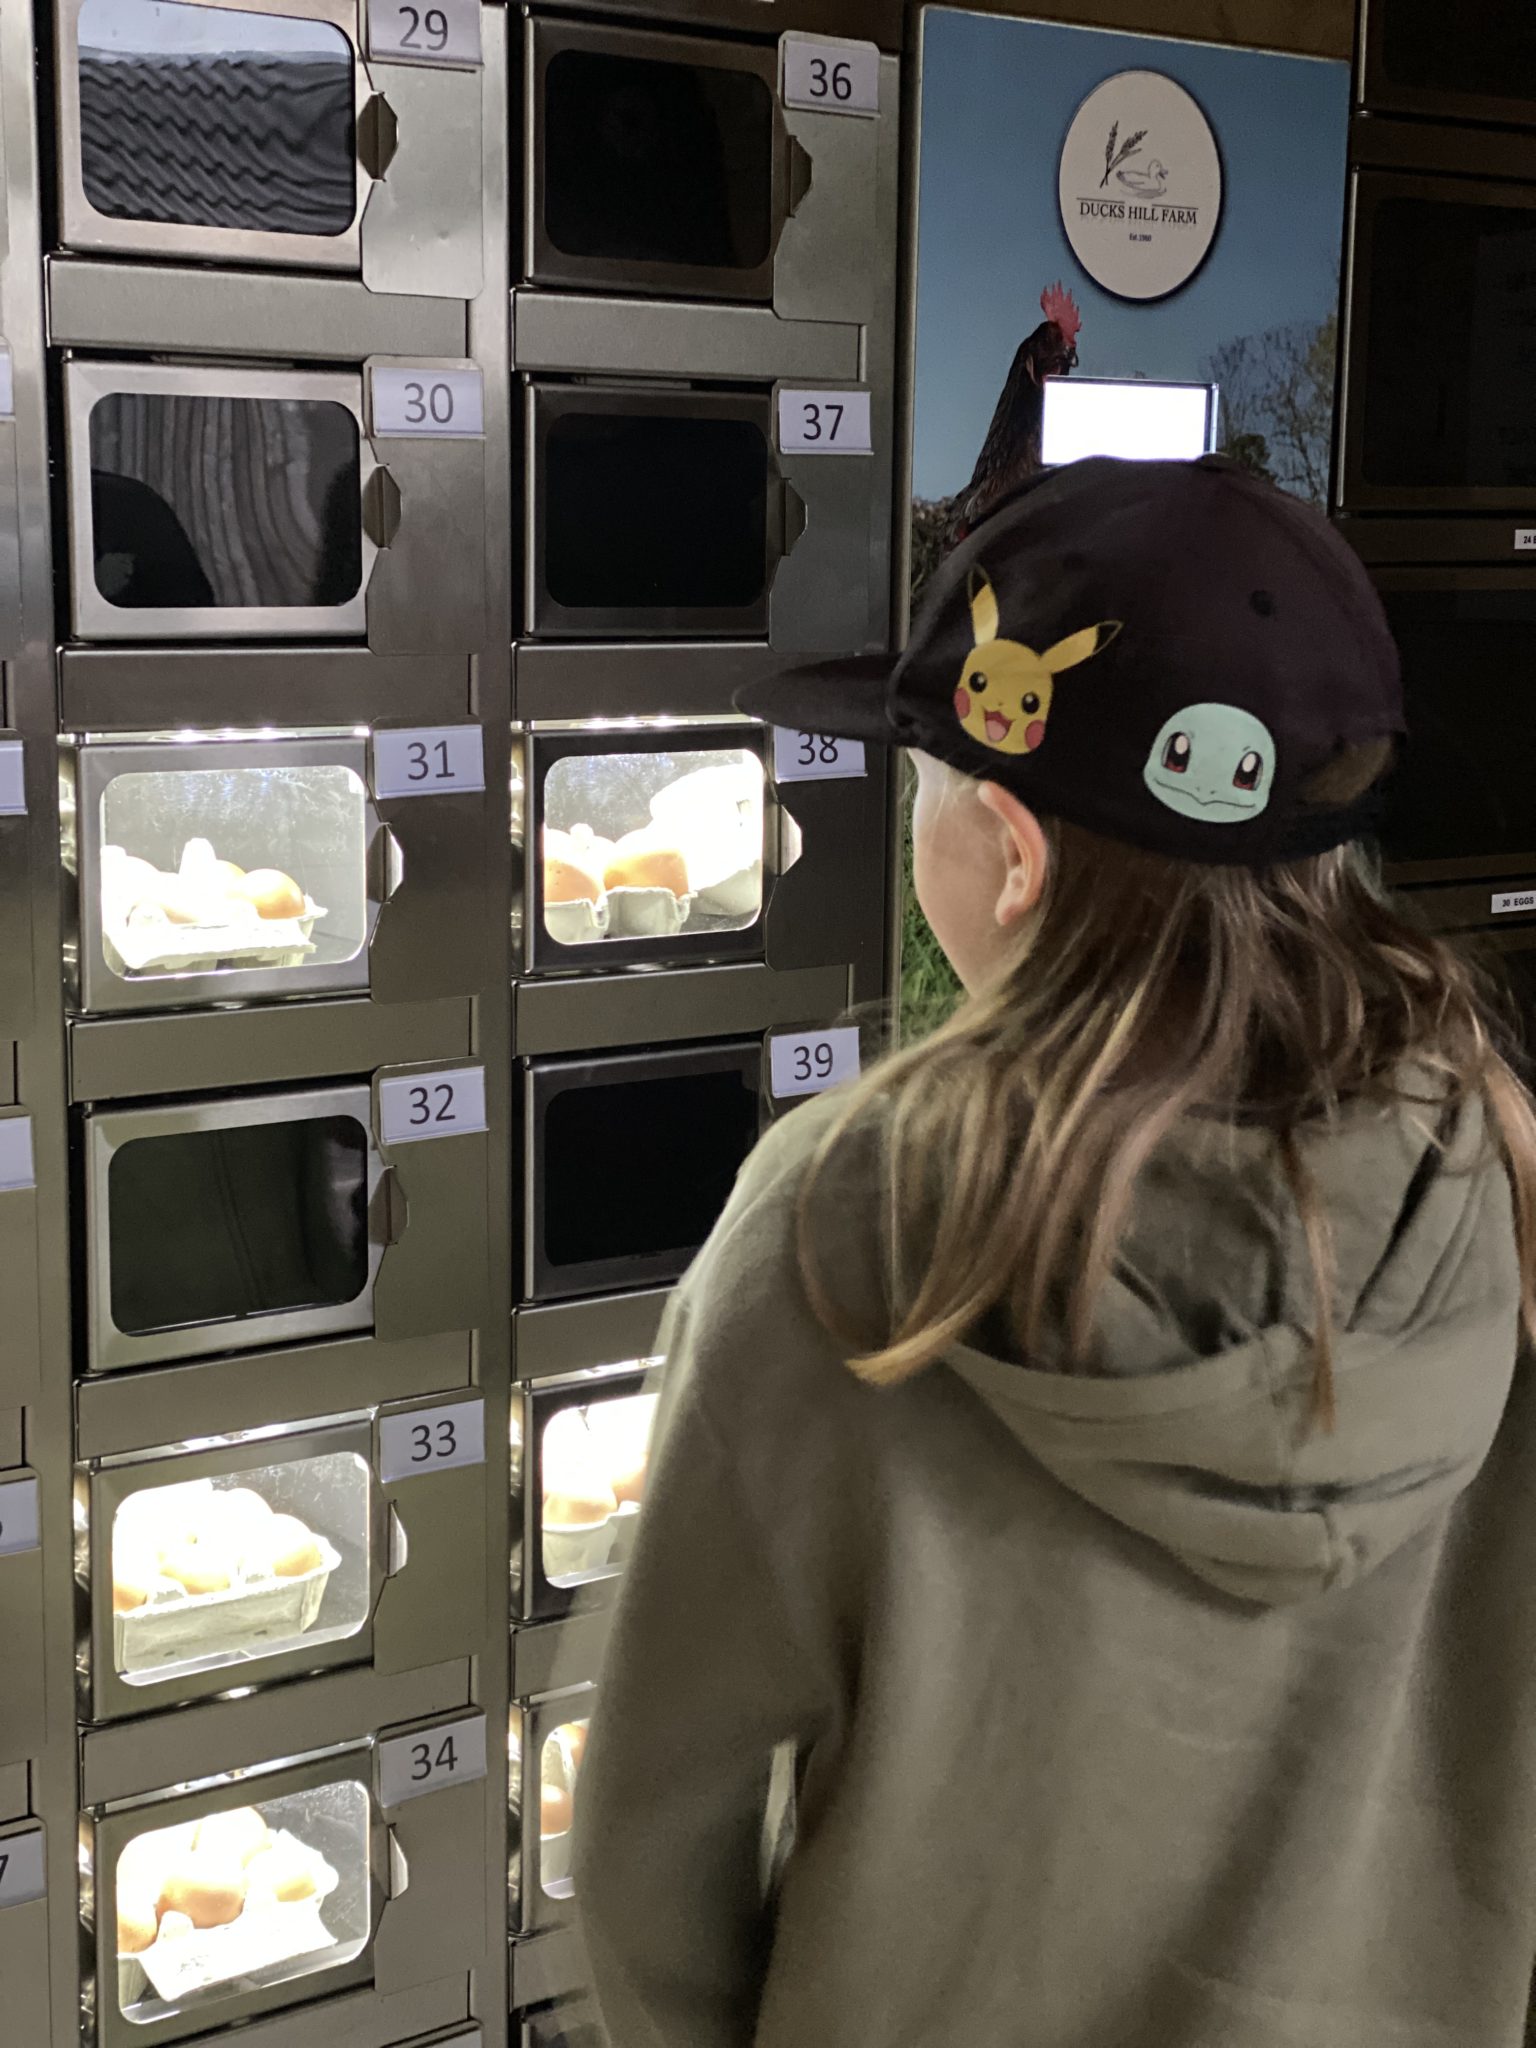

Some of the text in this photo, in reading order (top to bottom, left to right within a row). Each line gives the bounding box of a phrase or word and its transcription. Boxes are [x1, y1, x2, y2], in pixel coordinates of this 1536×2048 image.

[399, 6, 448, 50] 29
[809, 58, 852, 101] 36
[1080, 202, 1197, 224] DUCKS HILL FARM
[404, 383, 454, 423] 30
[803, 403, 844, 441] 37
[407, 740, 455, 780] 31
[798, 731, 838, 765] 38
[1514, 896, 1534, 906] EGGS
[794, 1042, 833, 1081] 39
[409, 1084, 456, 1125] 32
[411, 1420, 457, 1462] 33
[411, 1735, 458, 1781] 34
